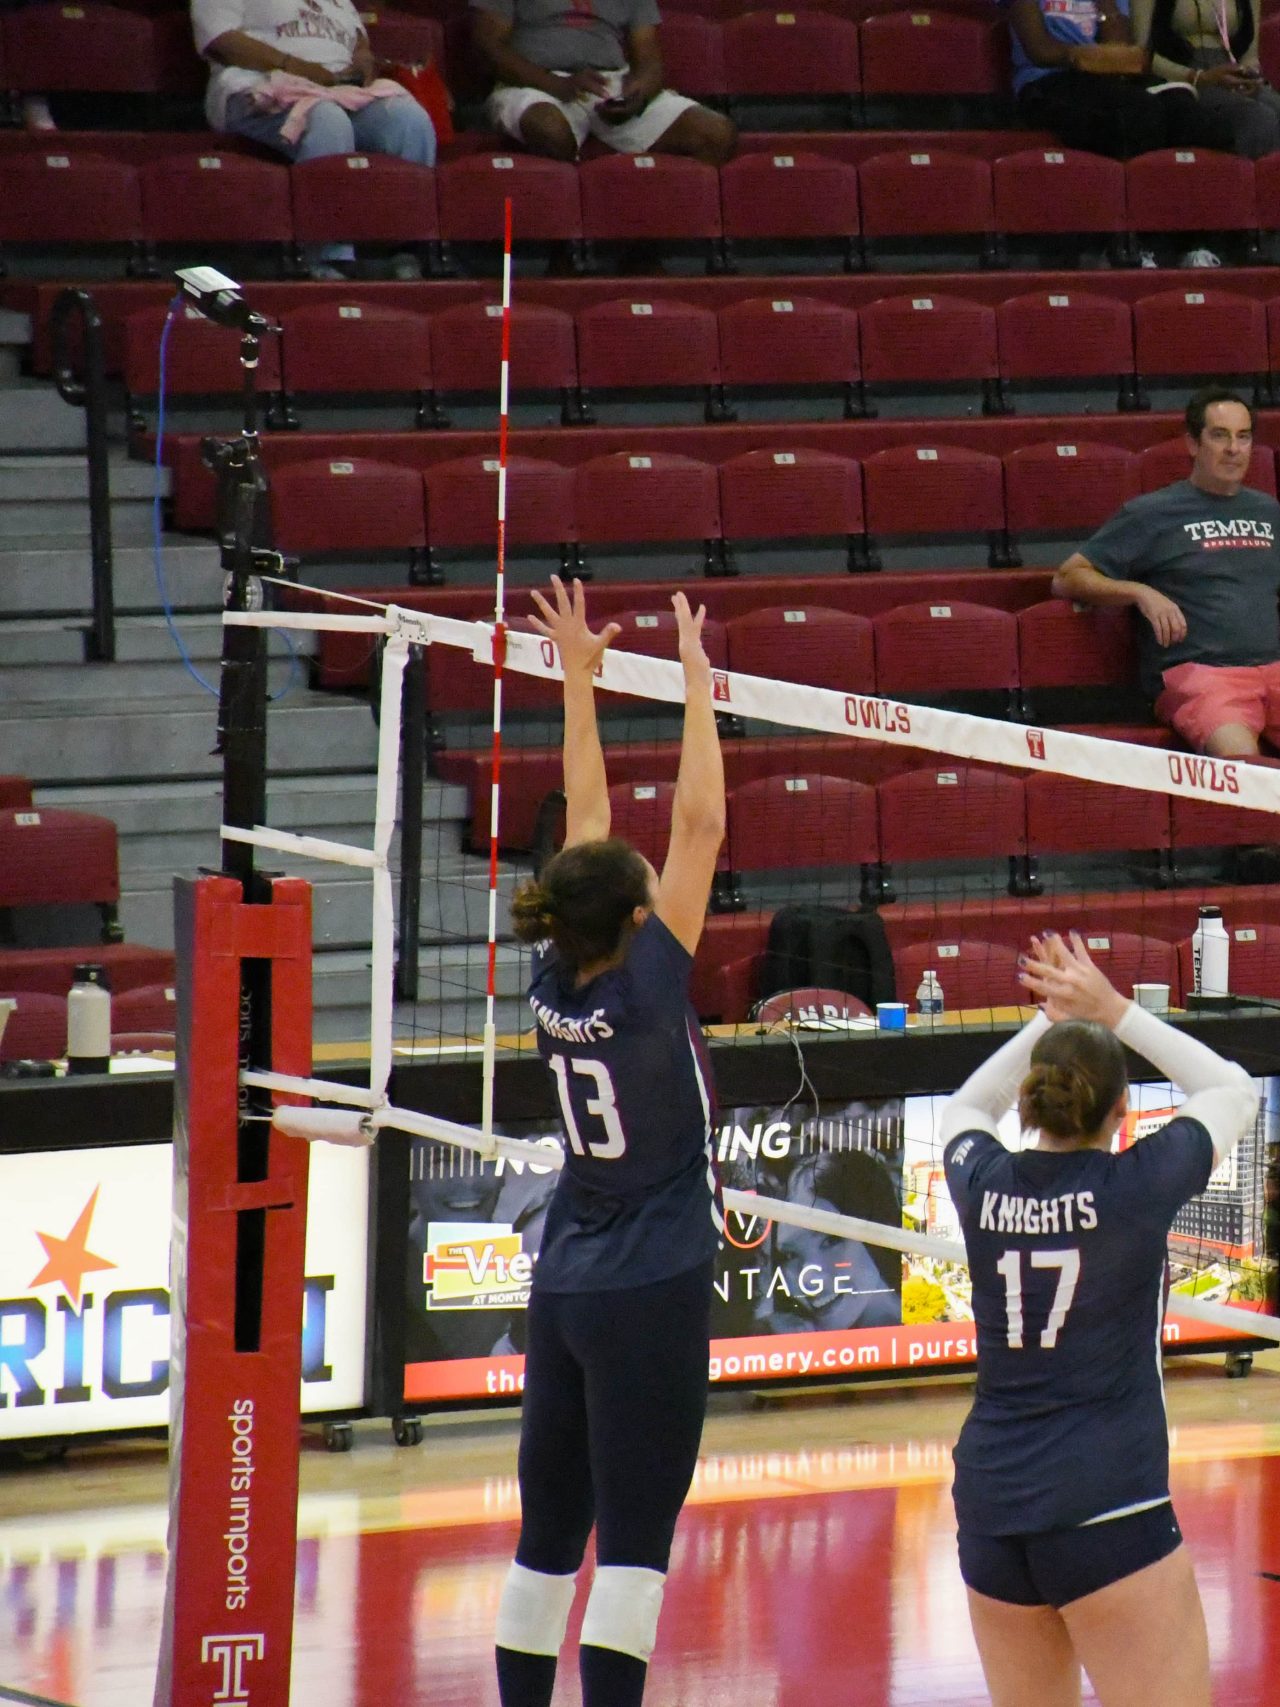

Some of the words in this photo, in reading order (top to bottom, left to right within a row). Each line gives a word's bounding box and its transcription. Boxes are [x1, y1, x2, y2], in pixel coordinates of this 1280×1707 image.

[1184, 519, 1275, 541] TEMPLE
[844, 696, 911, 734] OWLS
[1168, 754, 1240, 794] OWLS
[549, 1053, 627, 1160] 13
[979, 1190, 1098, 1234] KNIGHTS
[713, 1262, 854, 1303] NTAGE
[997, 1248, 1081, 1348] 17
[228, 1399, 255, 1491] sports
[223, 1497, 250, 1610] imports
